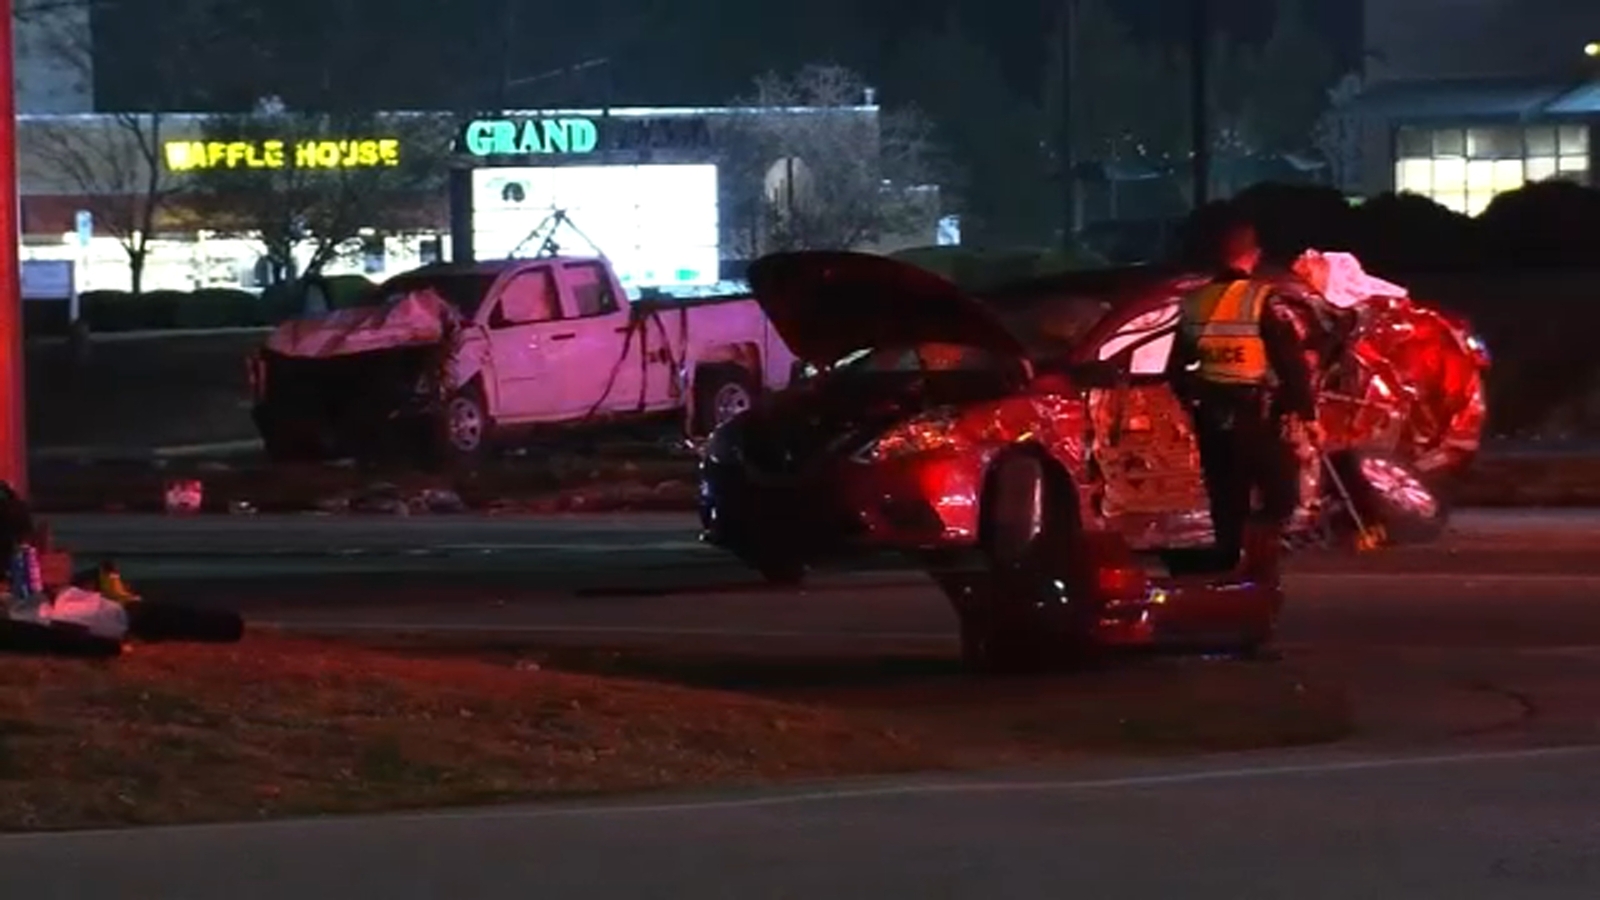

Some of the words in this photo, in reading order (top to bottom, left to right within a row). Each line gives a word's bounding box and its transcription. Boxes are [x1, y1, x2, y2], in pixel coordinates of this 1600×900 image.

[466, 118, 598, 155] GRAND
[164, 140, 284, 171] WAFFLE
[296, 139, 399, 168] HOUSE
